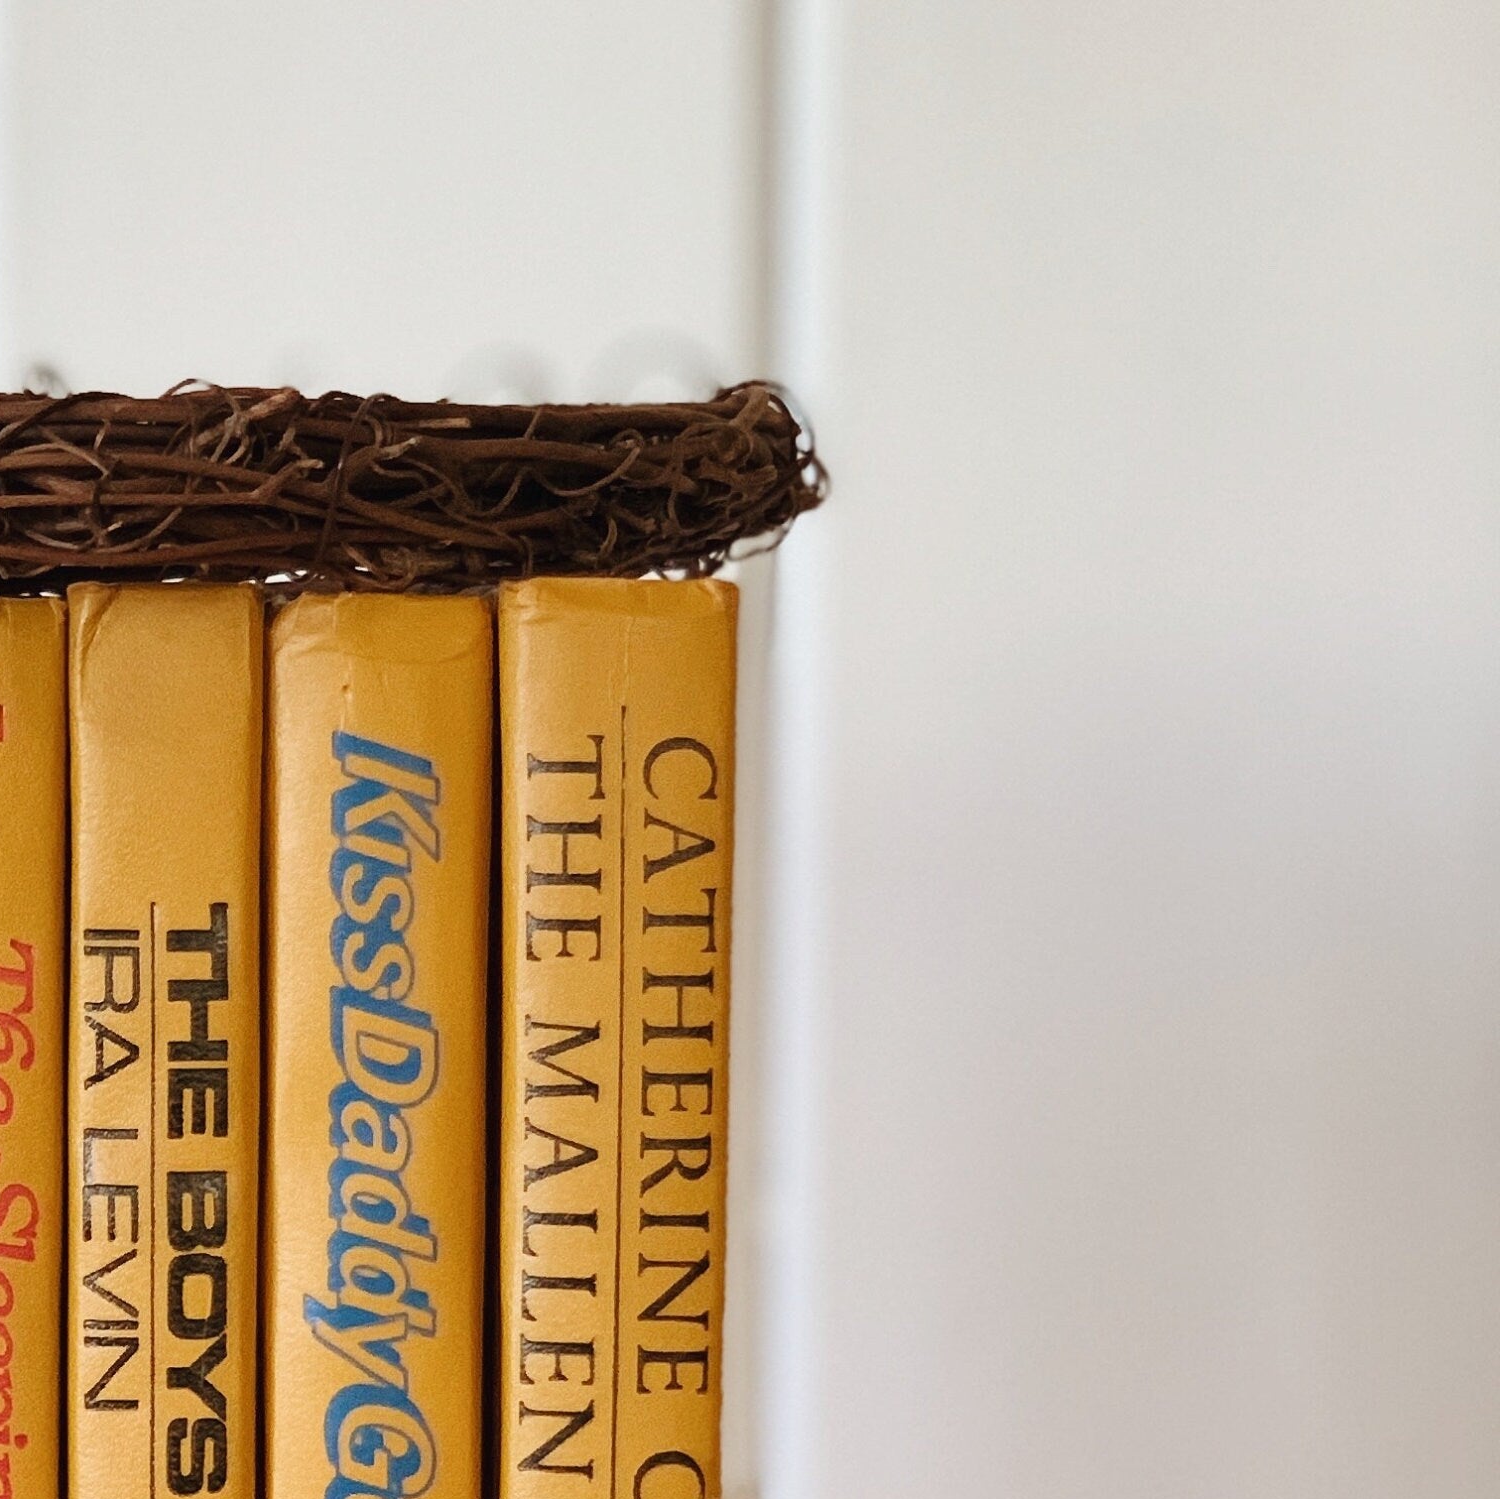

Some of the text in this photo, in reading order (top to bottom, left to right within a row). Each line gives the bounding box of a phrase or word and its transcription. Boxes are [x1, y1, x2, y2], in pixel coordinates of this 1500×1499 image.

[166, 902, 229, 1140] THE
[526, 734, 605, 962] THE
[83, 929, 141, 1412] IRA LEVIN
[517, 1014, 602, 1483] MALLEN
[635, 736, 718, 1396] CATHERINE
[166, 1170, 228, 1496] BOYS
